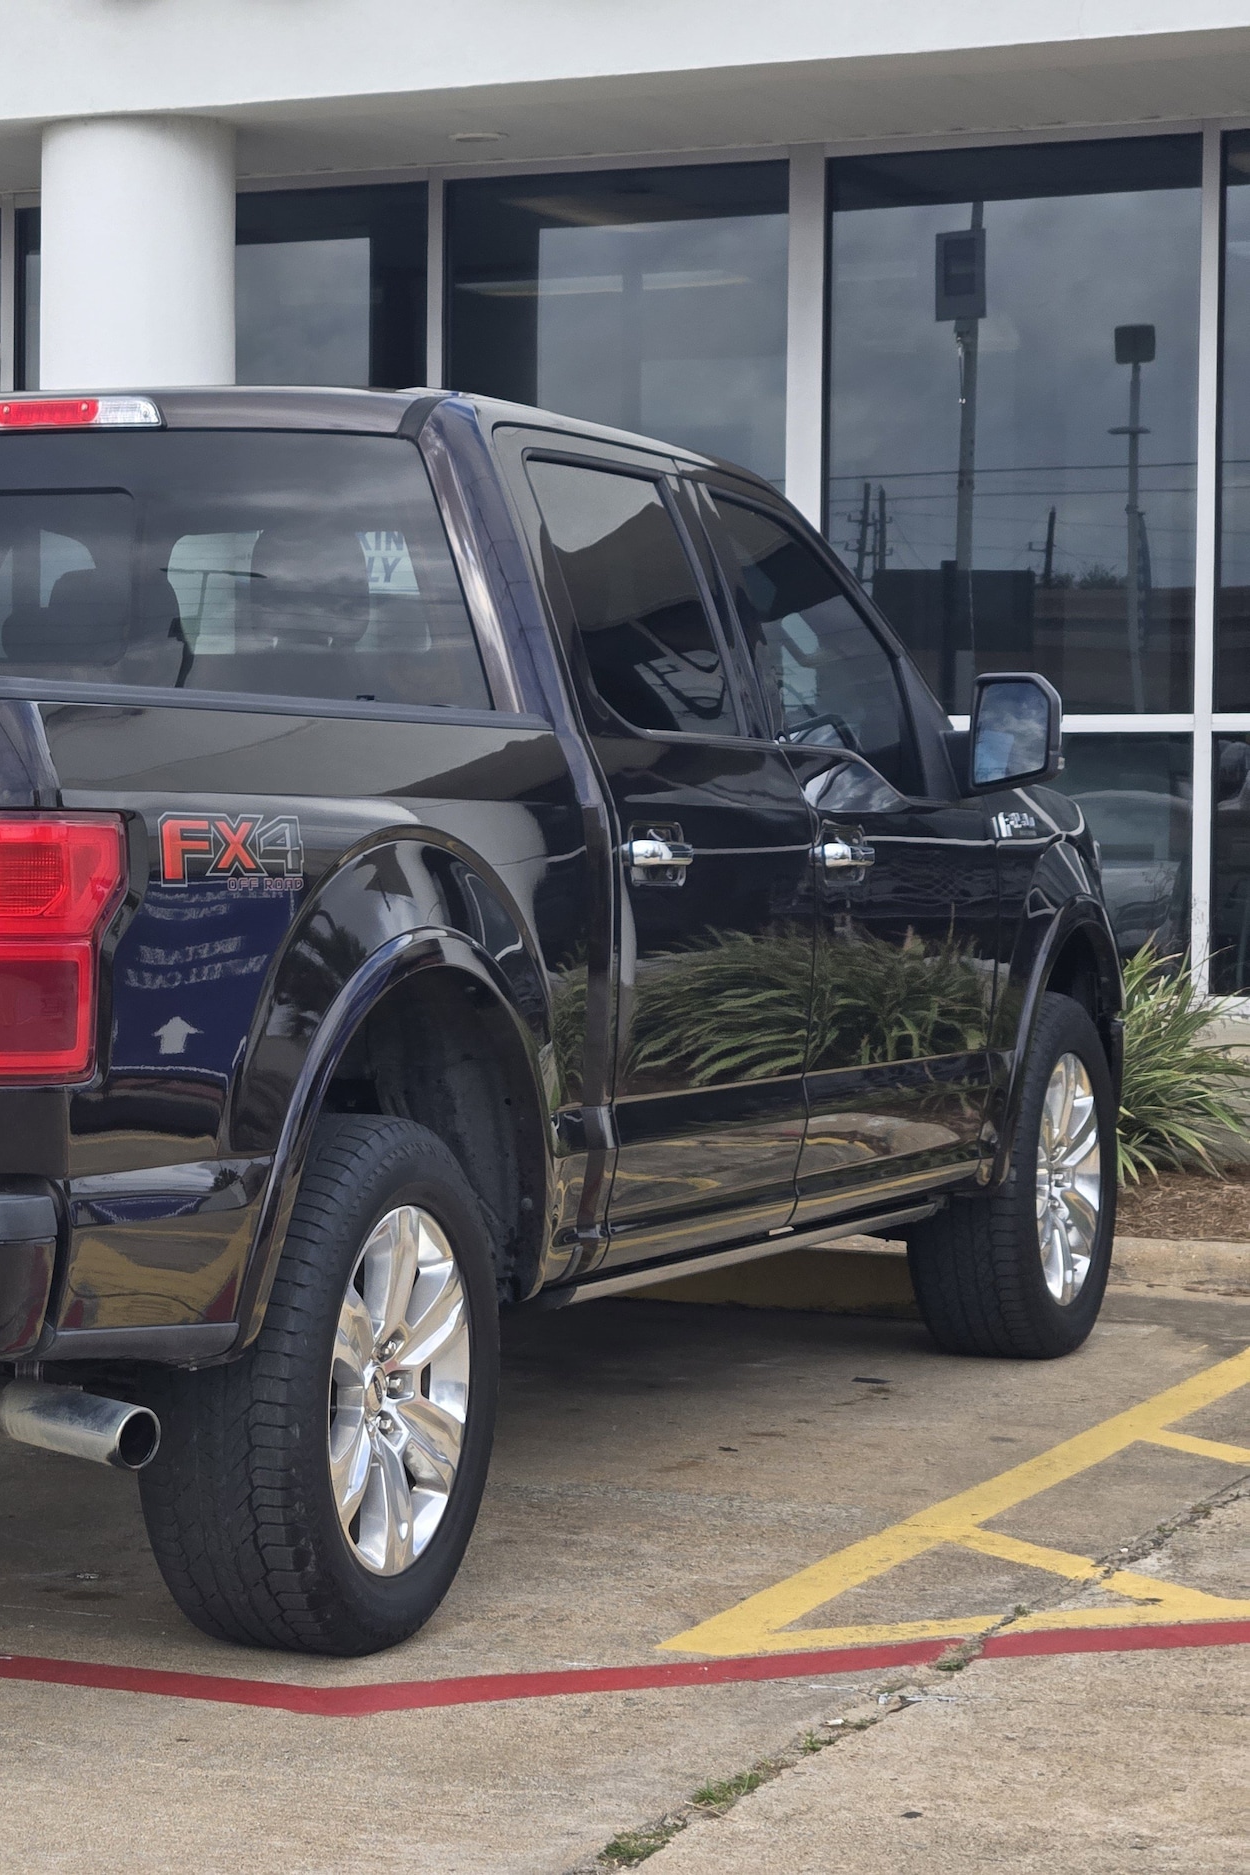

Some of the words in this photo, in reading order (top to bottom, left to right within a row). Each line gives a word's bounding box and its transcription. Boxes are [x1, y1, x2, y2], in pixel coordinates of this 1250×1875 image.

[158, 812, 304, 887] FX4
[227, 878, 259, 891] OFF
[263, 878, 304, 891] ROAD
